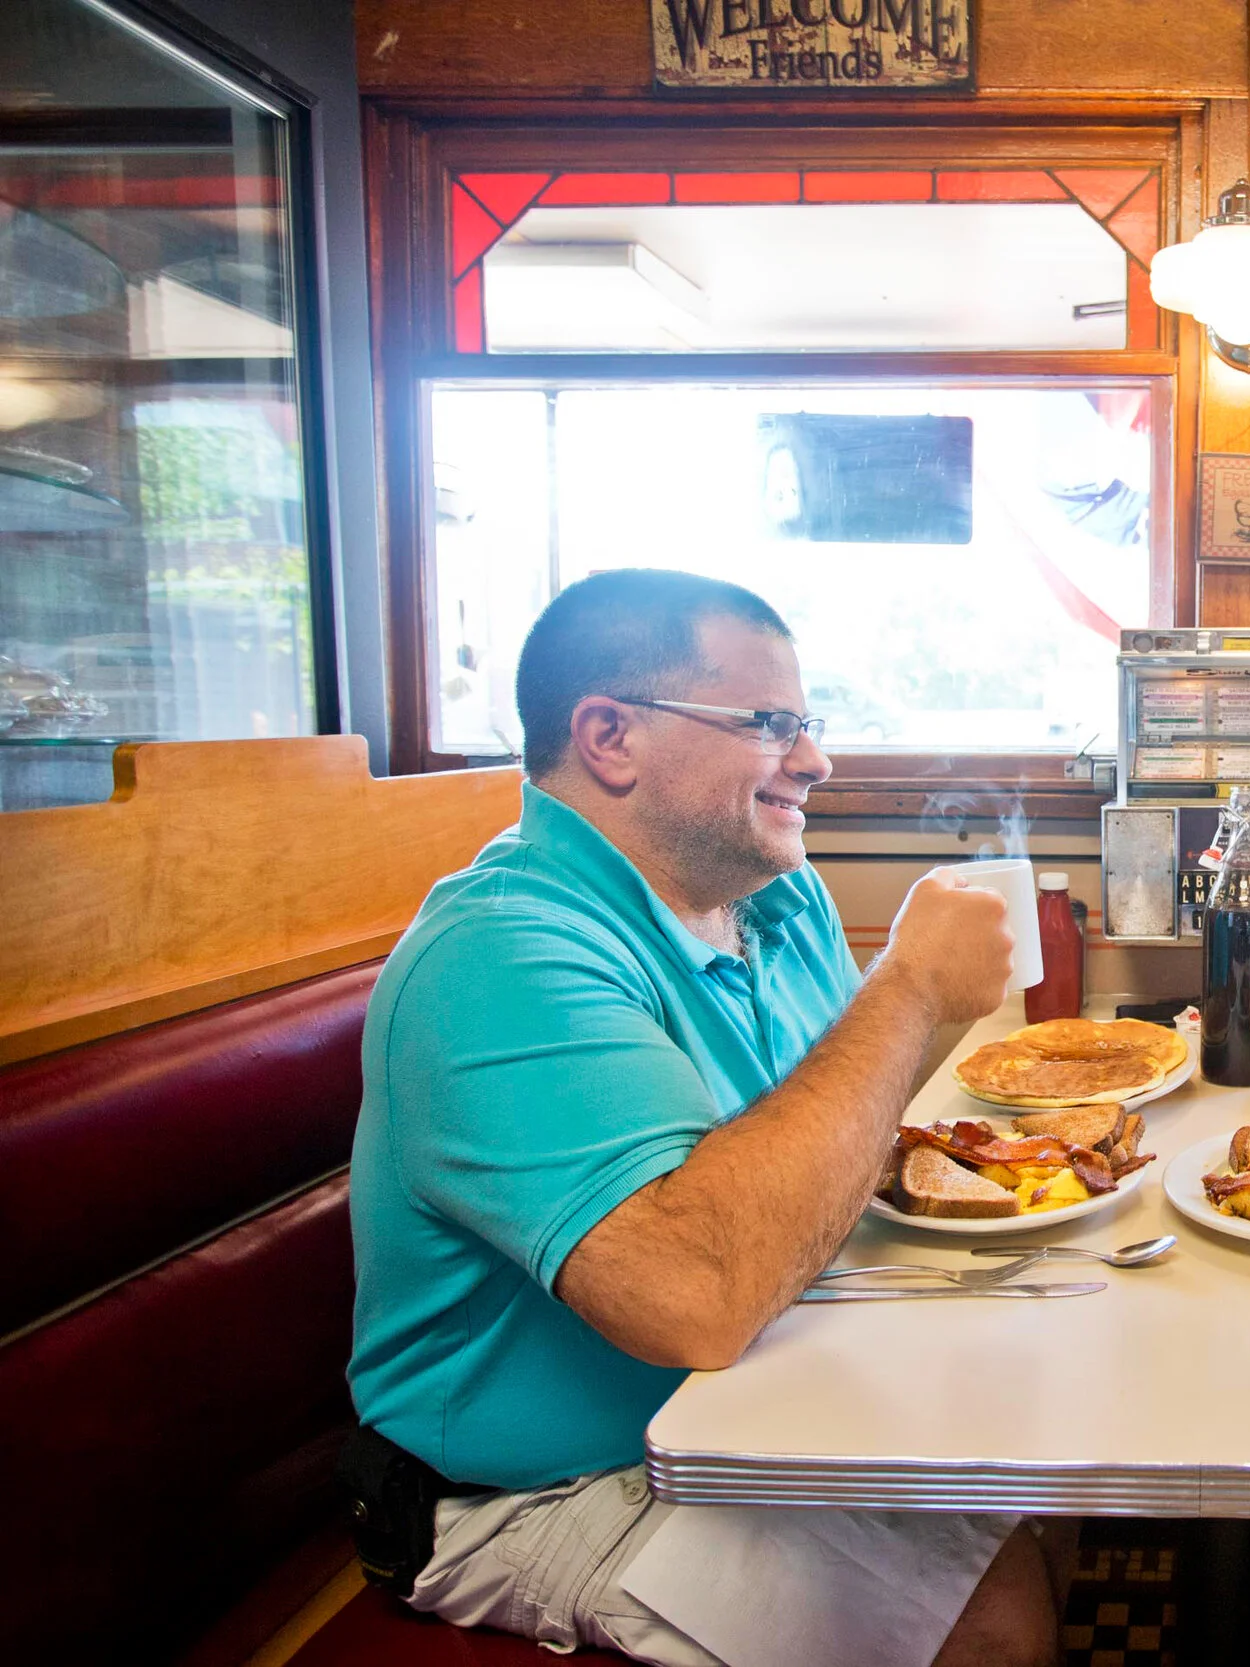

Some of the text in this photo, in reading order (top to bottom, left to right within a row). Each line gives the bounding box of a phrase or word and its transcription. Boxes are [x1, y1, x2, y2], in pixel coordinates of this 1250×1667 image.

[746, 39, 883, 79] Friends
[1181, 875, 1190, 888] A
[1195, 875, 1204, 888] B
[1182, 890, 1189, 903] L
[1195, 890, 1205, 903] M
